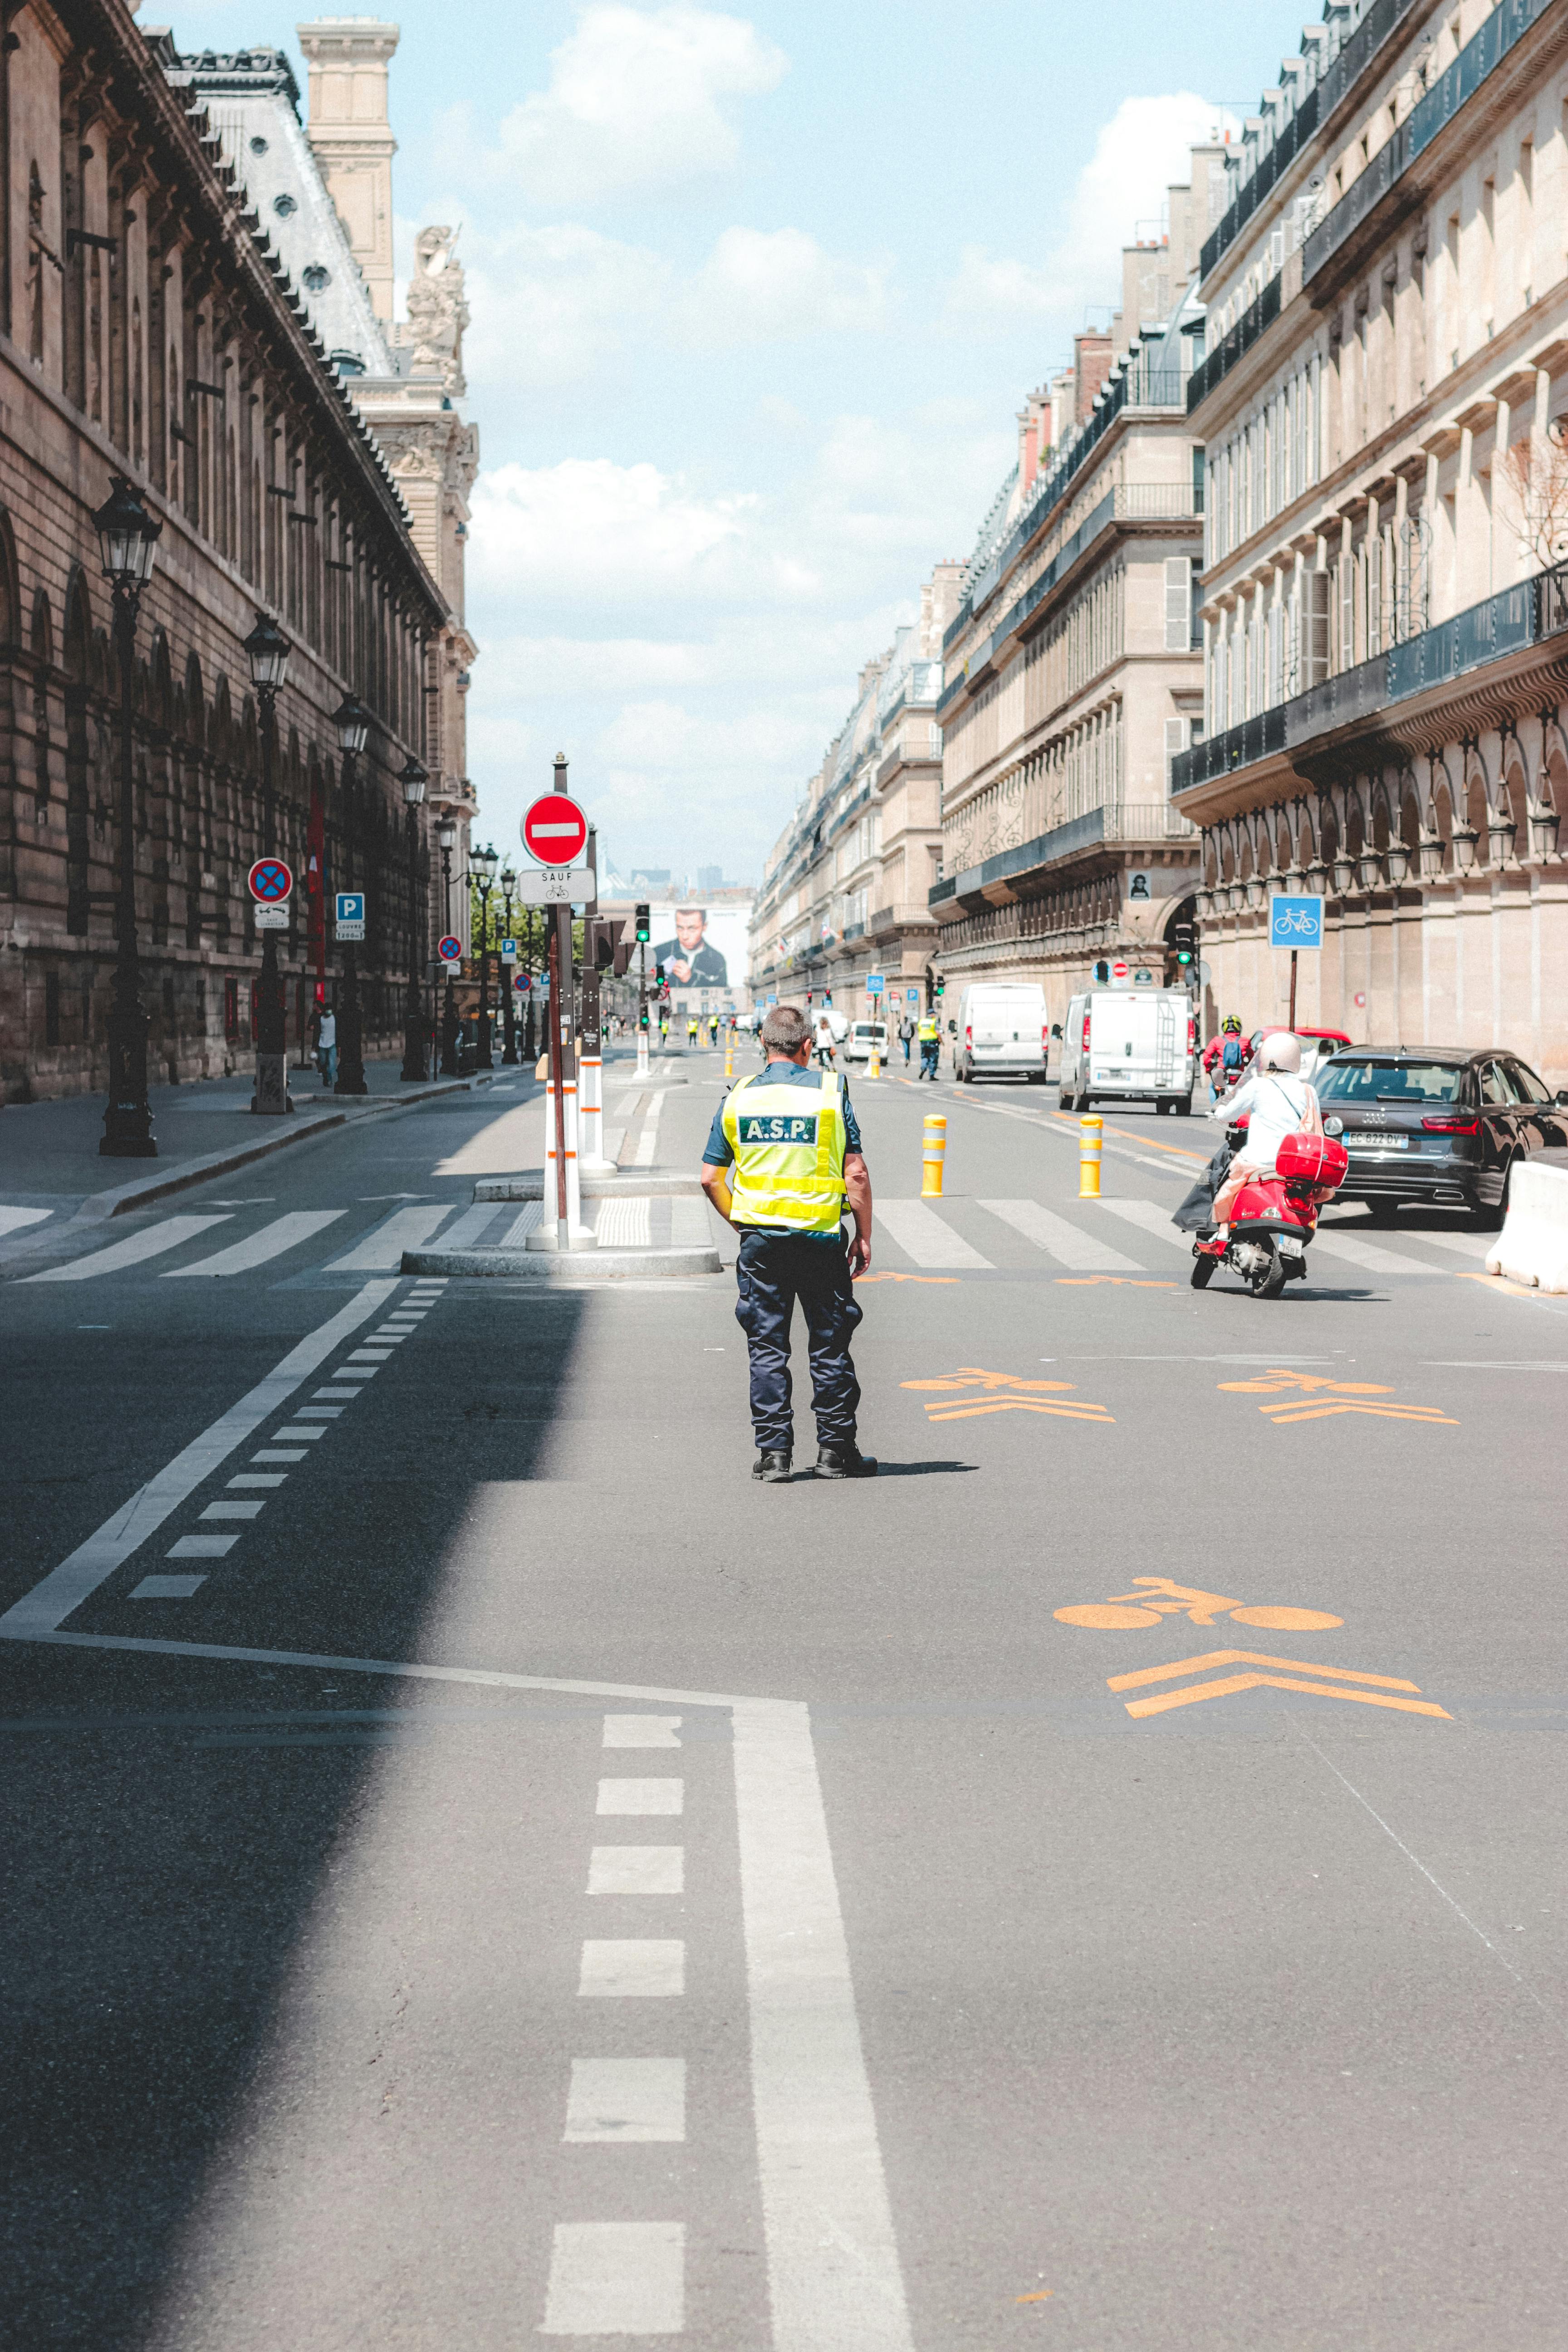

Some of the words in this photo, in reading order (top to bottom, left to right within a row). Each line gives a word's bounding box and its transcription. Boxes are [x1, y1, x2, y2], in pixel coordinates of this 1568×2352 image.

[542, 873, 571, 881] SAUF
[344, 899, 356, 916] P
[505, 942, 512, 951] P
[746, 1119, 809, 1140] A.S.P.
